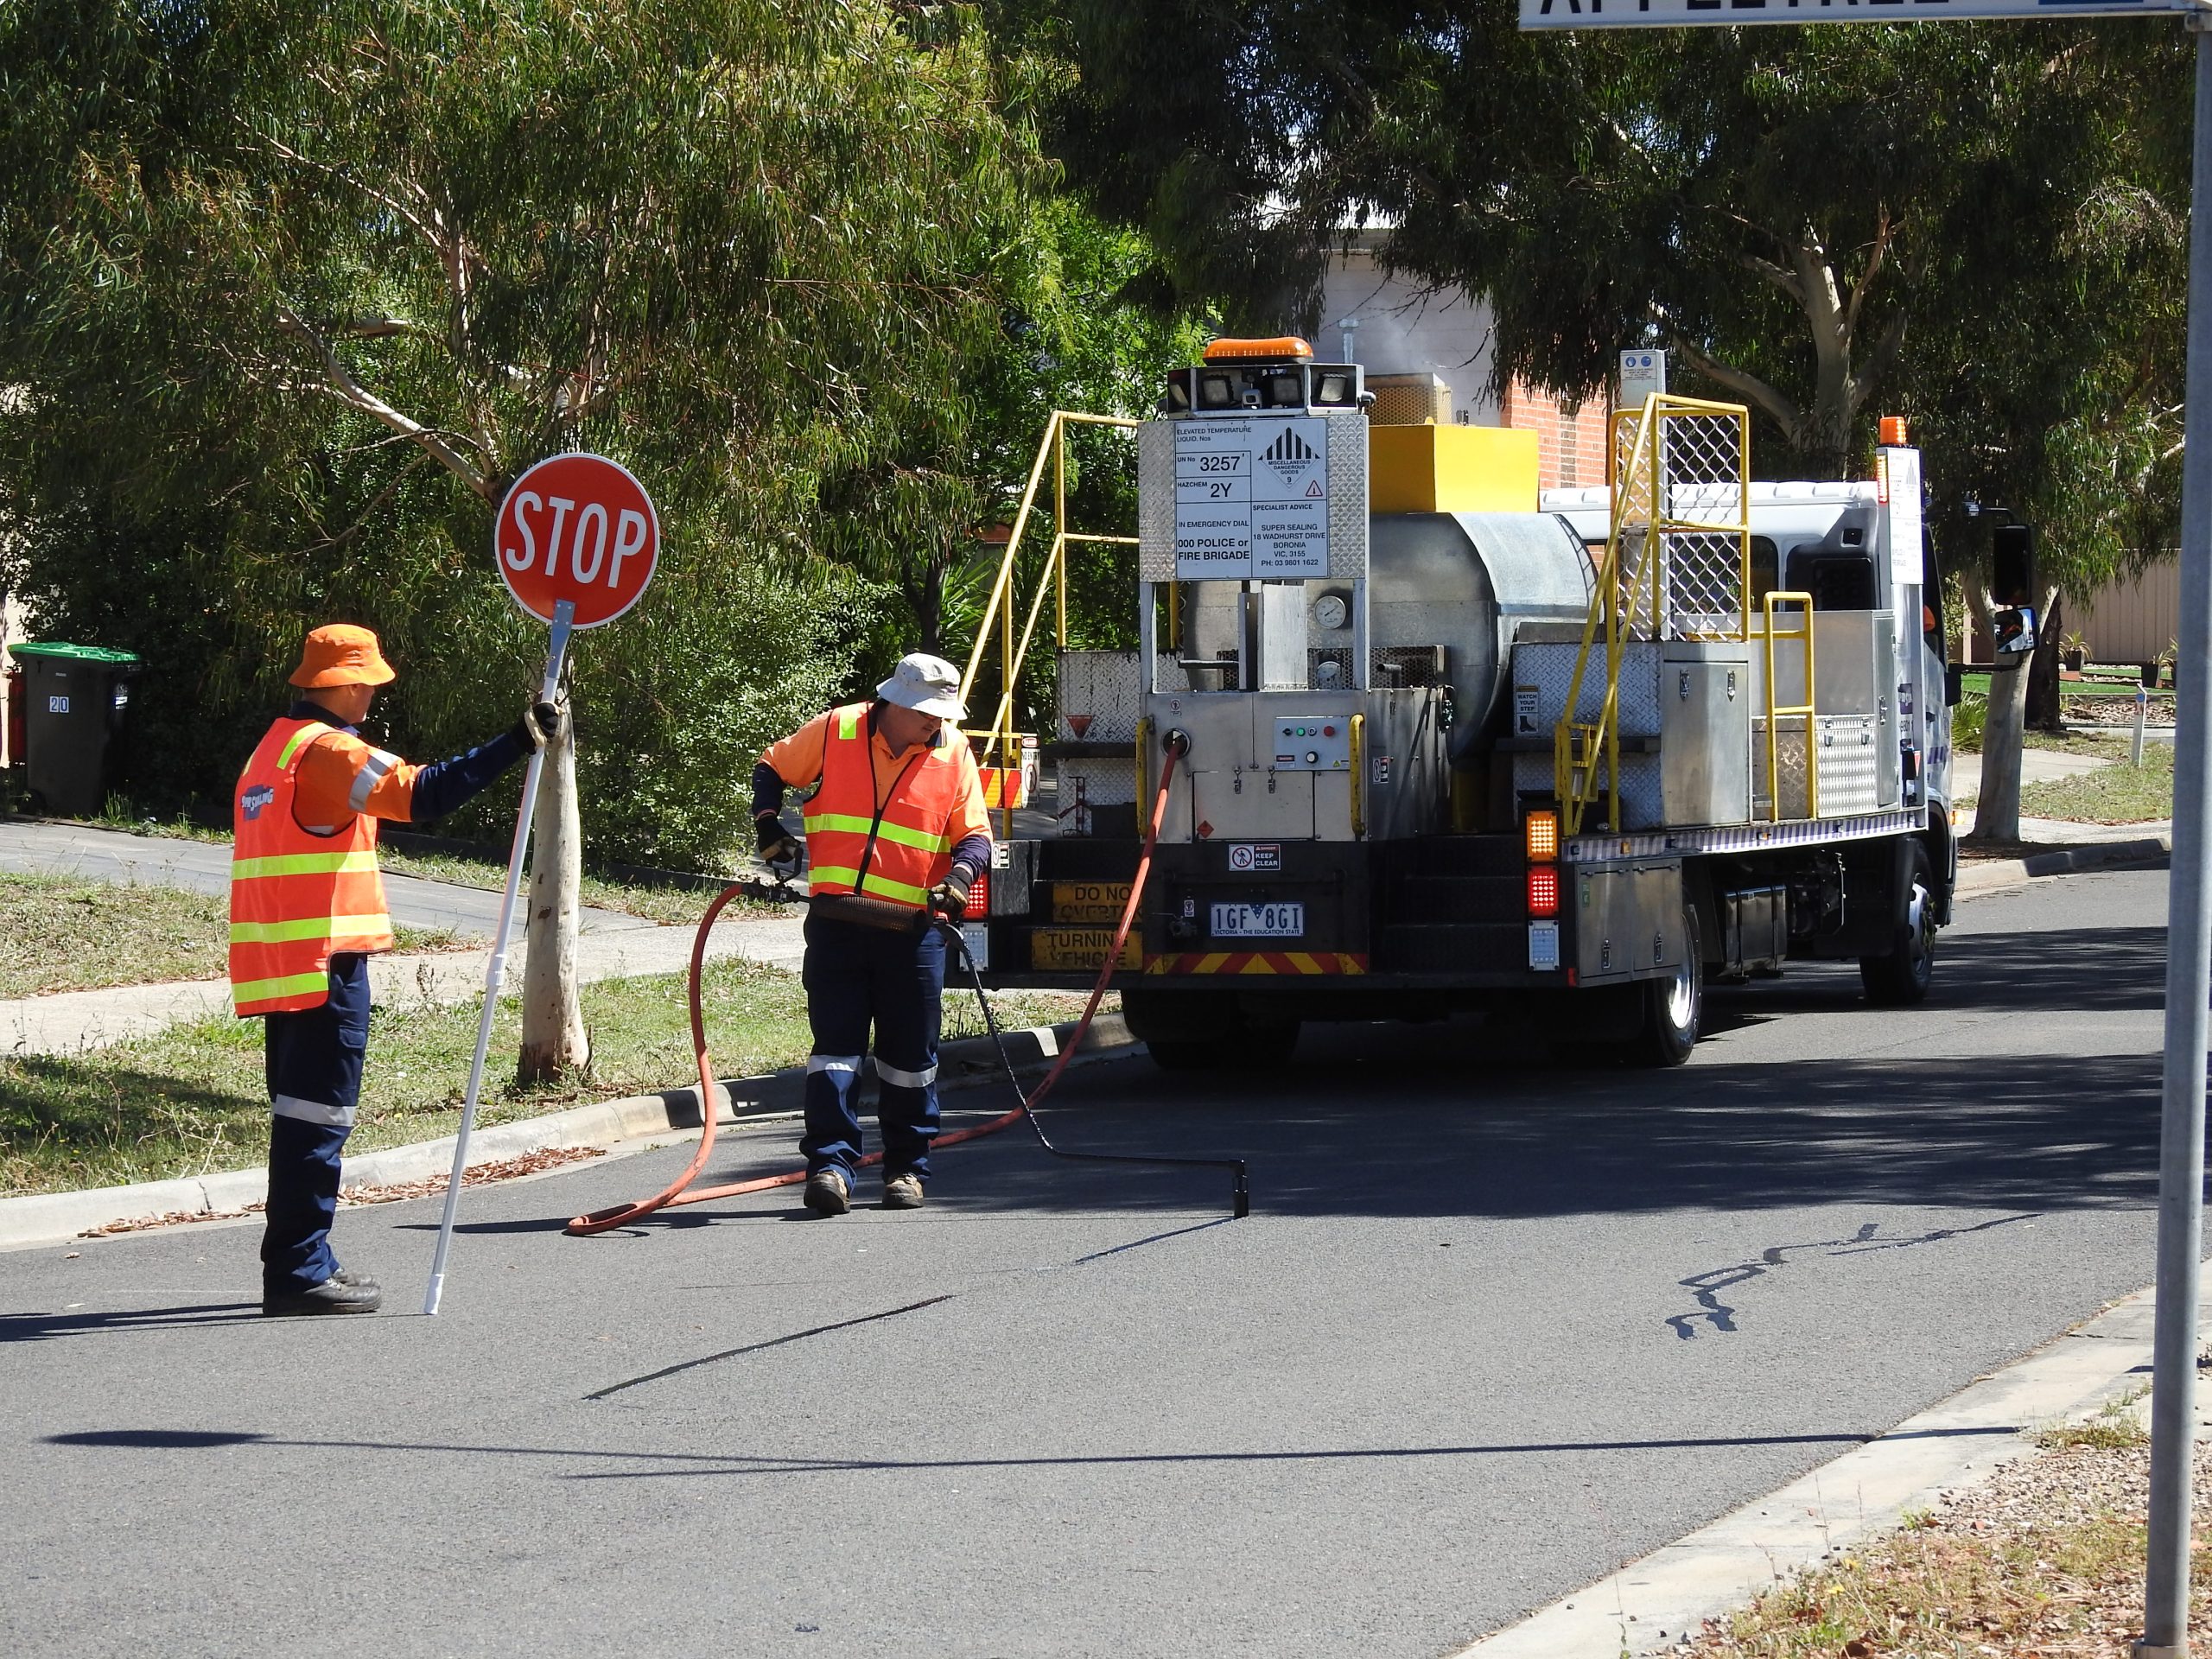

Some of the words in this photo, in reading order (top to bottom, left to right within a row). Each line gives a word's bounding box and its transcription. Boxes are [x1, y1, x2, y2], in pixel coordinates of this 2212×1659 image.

[1199, 456, 1241, 472] 3257
[1211, 482, 1232, 498] 2Y
[505, 491, 647, 588] STOP
[1178, 539, 1195, 548] 000
[1197, 538, 1236, 548] POLICE
[1178, 551, 1201, 561] FIRE
[1204, 550, 1250, 561] BRIGADE
[51, 696, 68, 711] 20
[1075, 887, 1100, 900] DO
[1107, 887, 1132, 900] NO
[1216, 907, 1249, 929] 1GF
[1047, 933, 1128, 947] TURNIN
